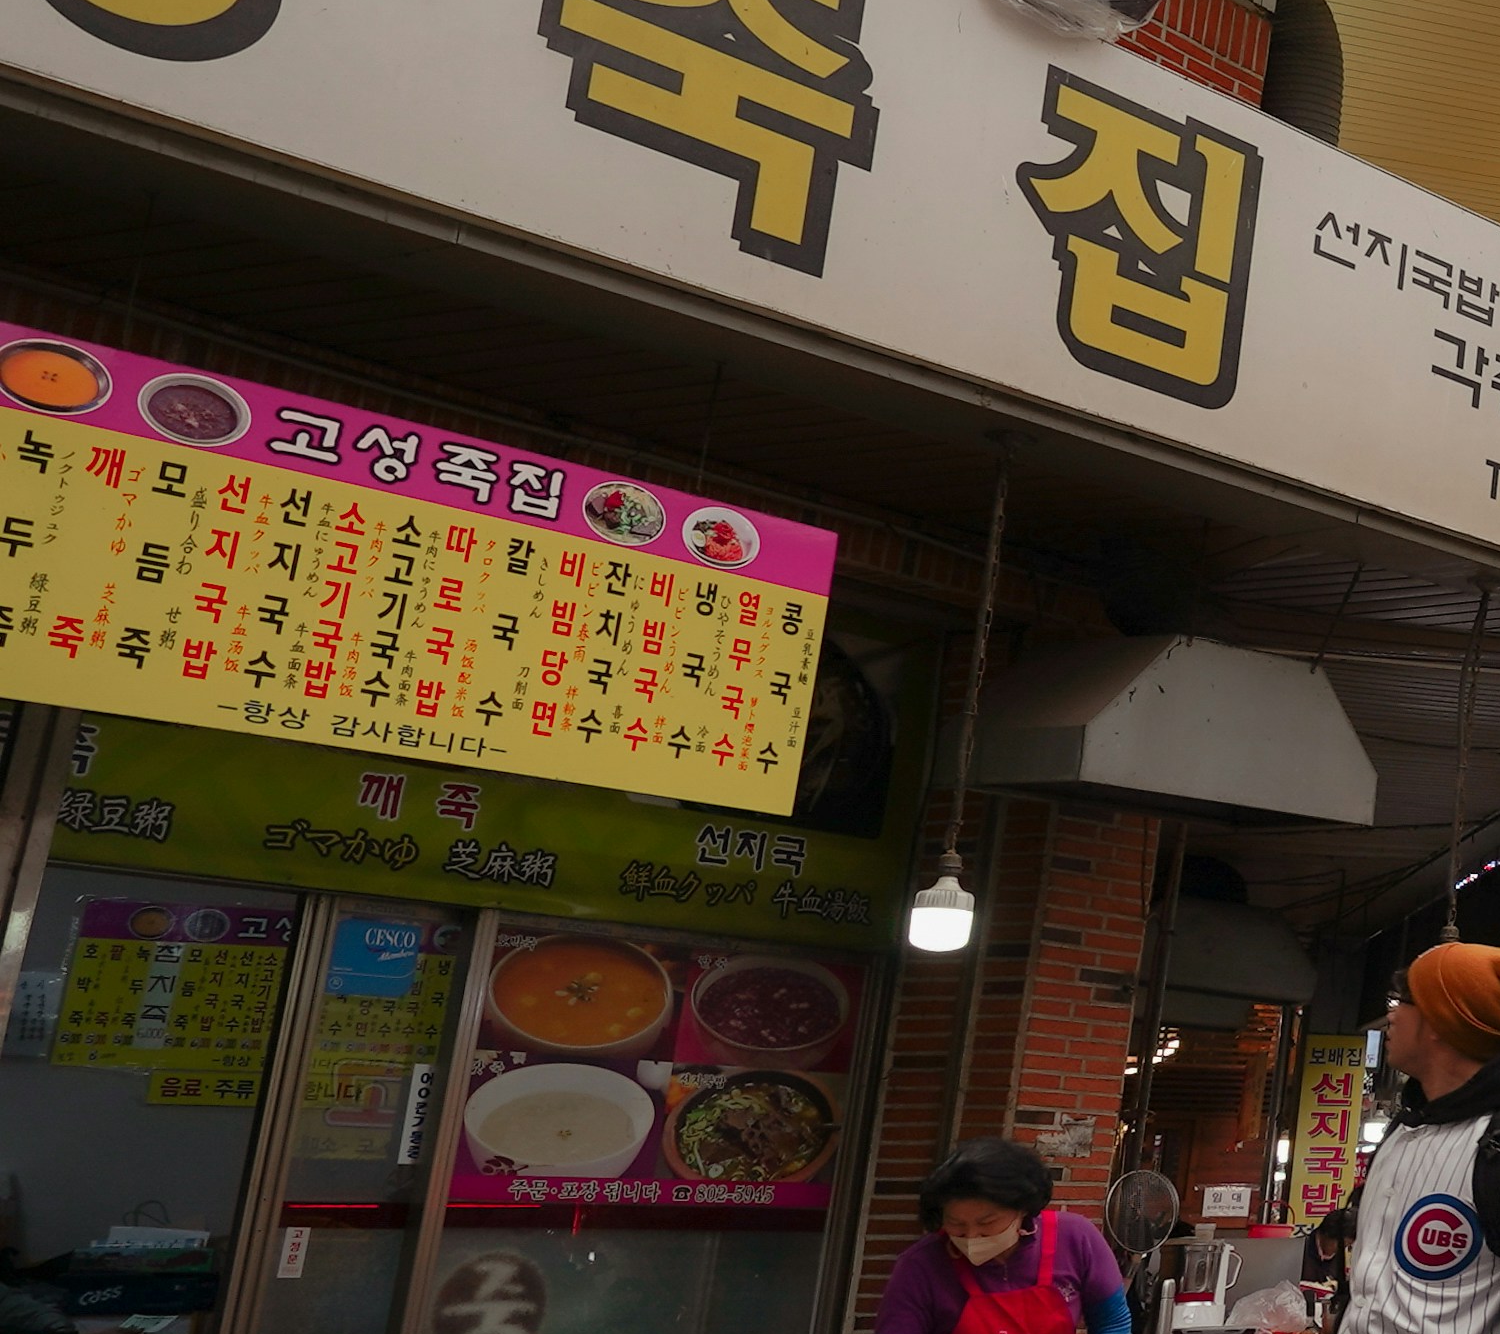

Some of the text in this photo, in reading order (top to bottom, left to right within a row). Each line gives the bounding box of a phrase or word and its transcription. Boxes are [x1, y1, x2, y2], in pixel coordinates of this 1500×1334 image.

[1314, 209, 1500, 328] 선지국밥
[269, 407, 567, 521] 고성죽집
[364, 927, 416, 948] CESCO
[1309, 1047, 1362, 1066] 보배집
[694, 1184, 775, 1205] 802-5945
